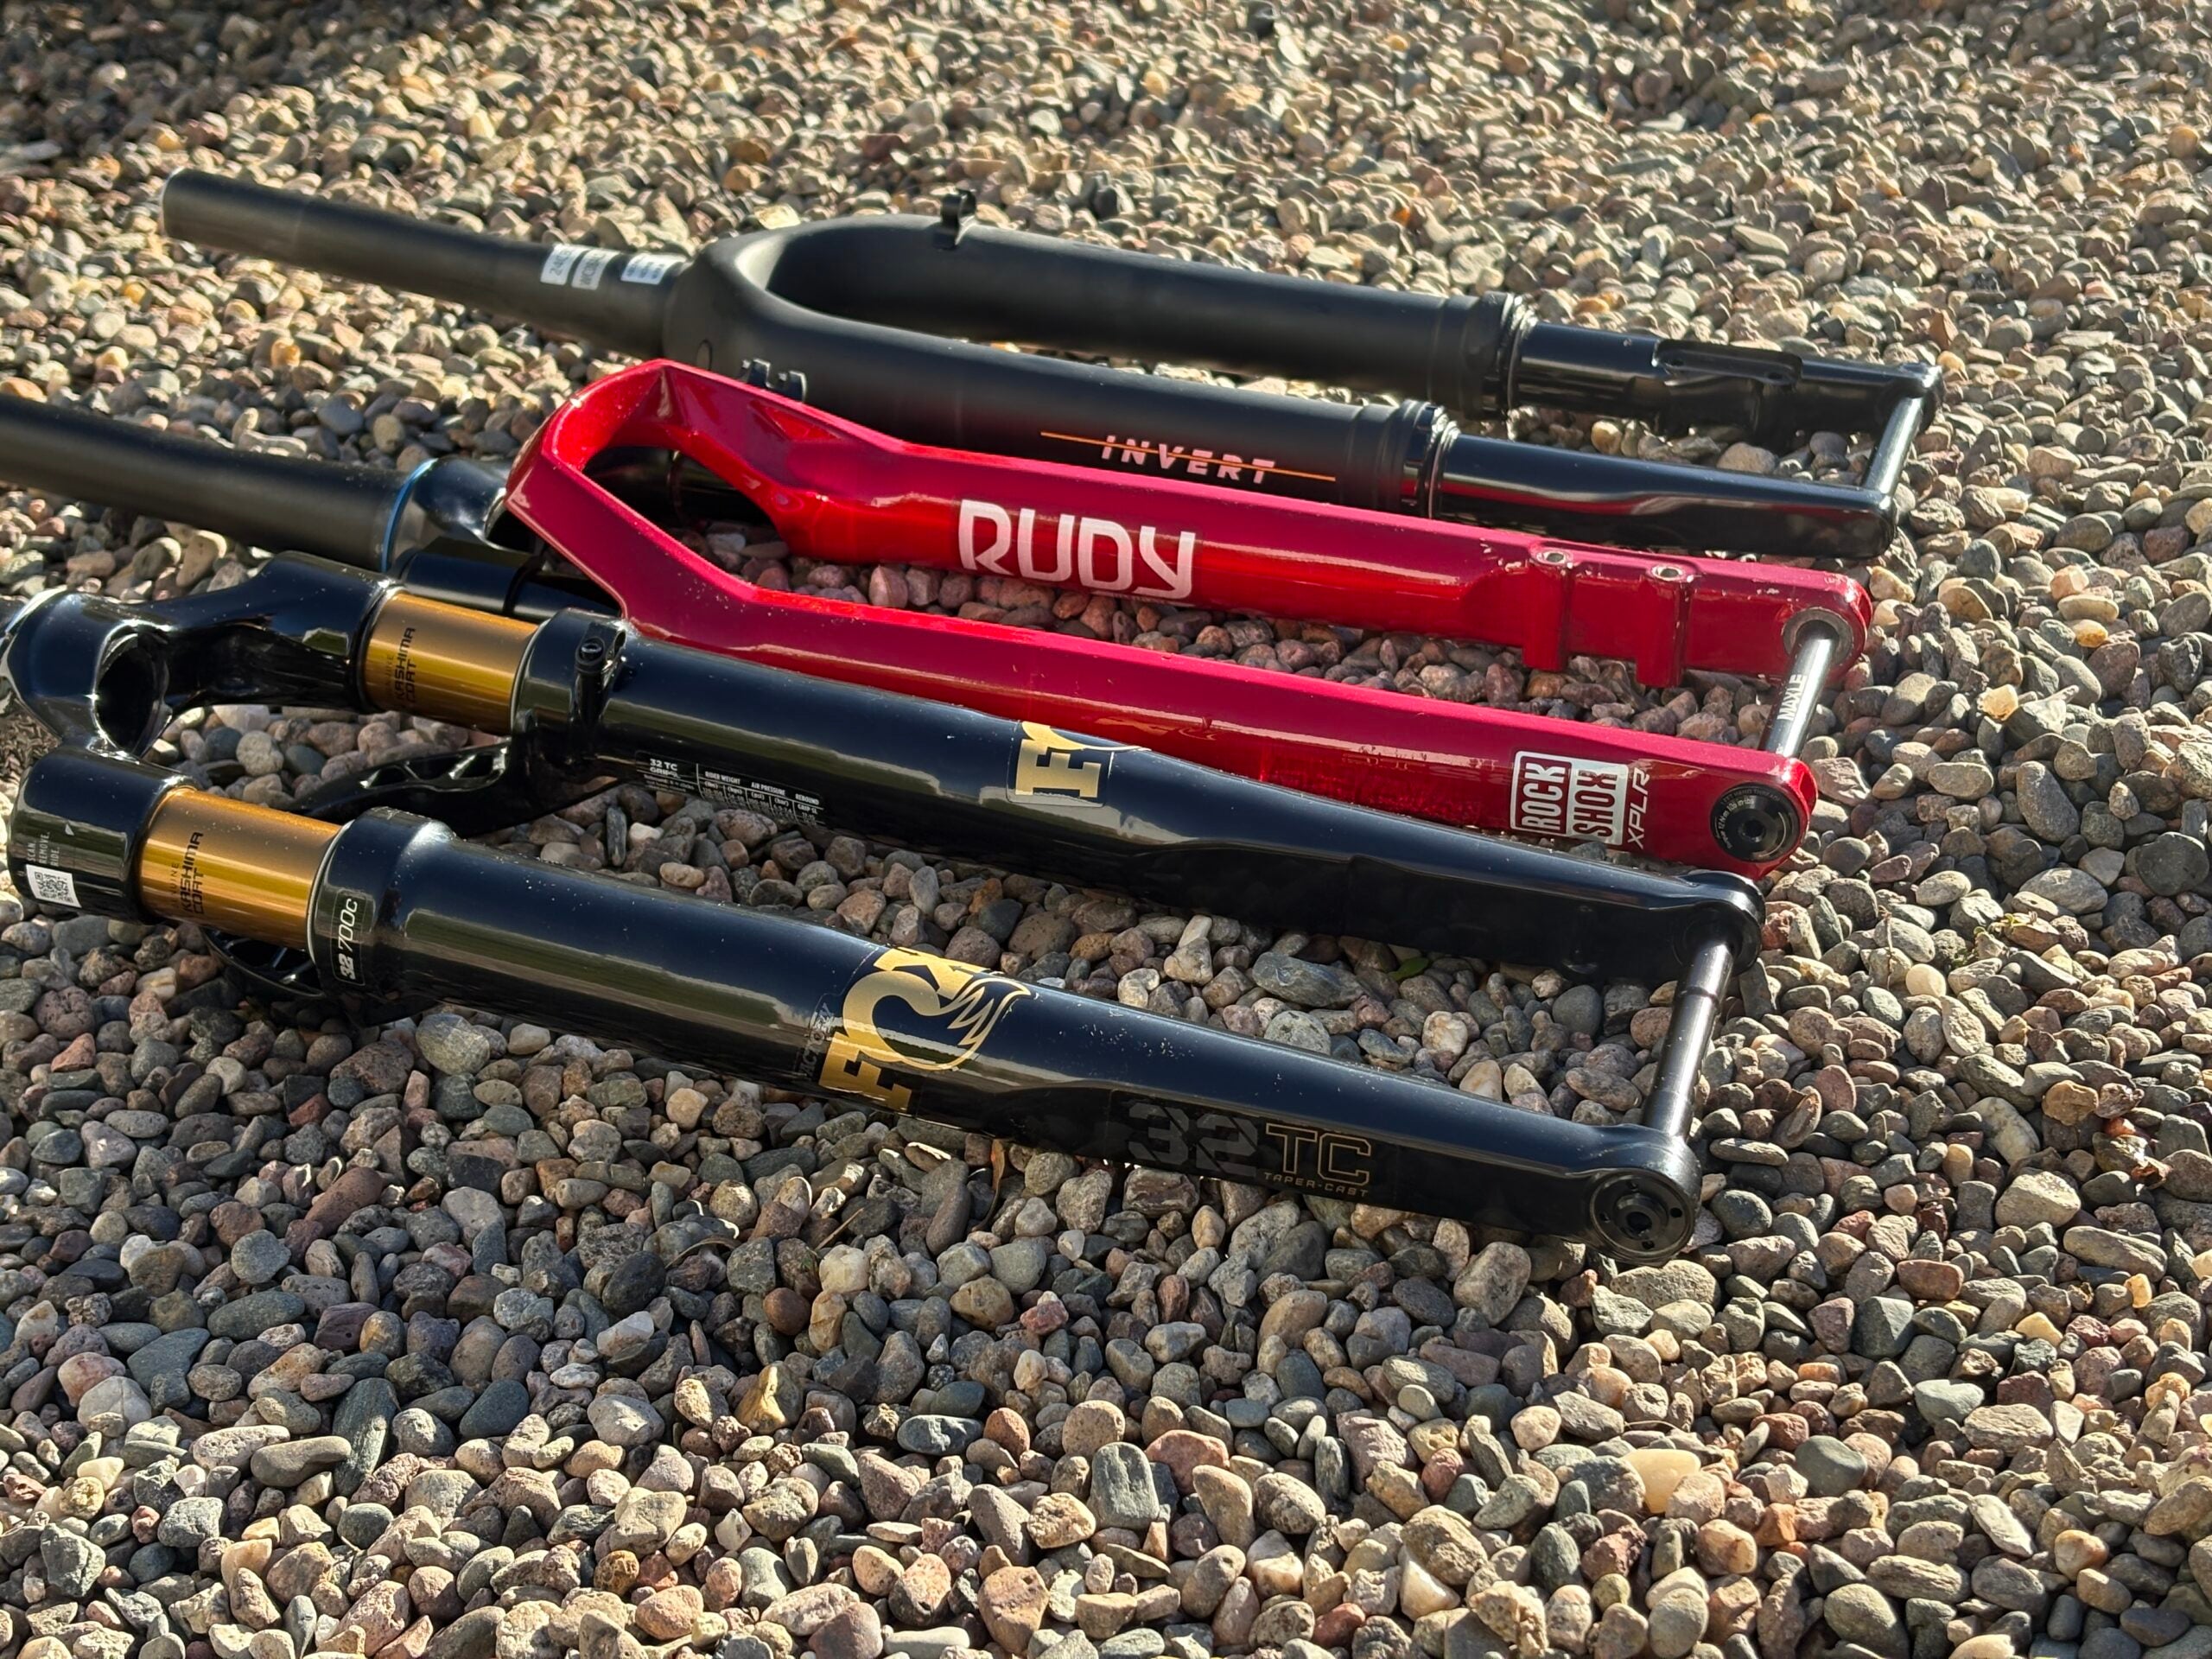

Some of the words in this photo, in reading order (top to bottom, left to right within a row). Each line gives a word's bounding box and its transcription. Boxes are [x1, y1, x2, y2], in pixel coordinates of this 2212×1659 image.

[1101, 435, 1276, 485] INVERT
[957, 499, 1197, 600] RUDY
[394, 627, 416, 700] KASHIMA
[405, 660, 416, 702] COAT
[1777, 673, 1807, 721] MAXLE
[649, 758, 663, 768] 32
[664, 761, 678, 772] TC
[795, 793, 820, 805] REBOUND
[1521, 762, 1566, 830] ROCK
[1572, 769, 1618, 838] SHOX
[1627, 766, 1650, 849] XPLR
[38, 831, 50, 864] REMOVE.
[180, 831, 204, 913] KASHIMA
[192, 867, 205, 914] COAT
[338, 953, 356, 980] 32
[818, 946, 1031, 1111] FOX
[1128, 1102, 1258, 1177] 32
[1266, 1122, 1371, 1186] TC
[1264, 1172, 1370, 1198] TAPER-CAST
